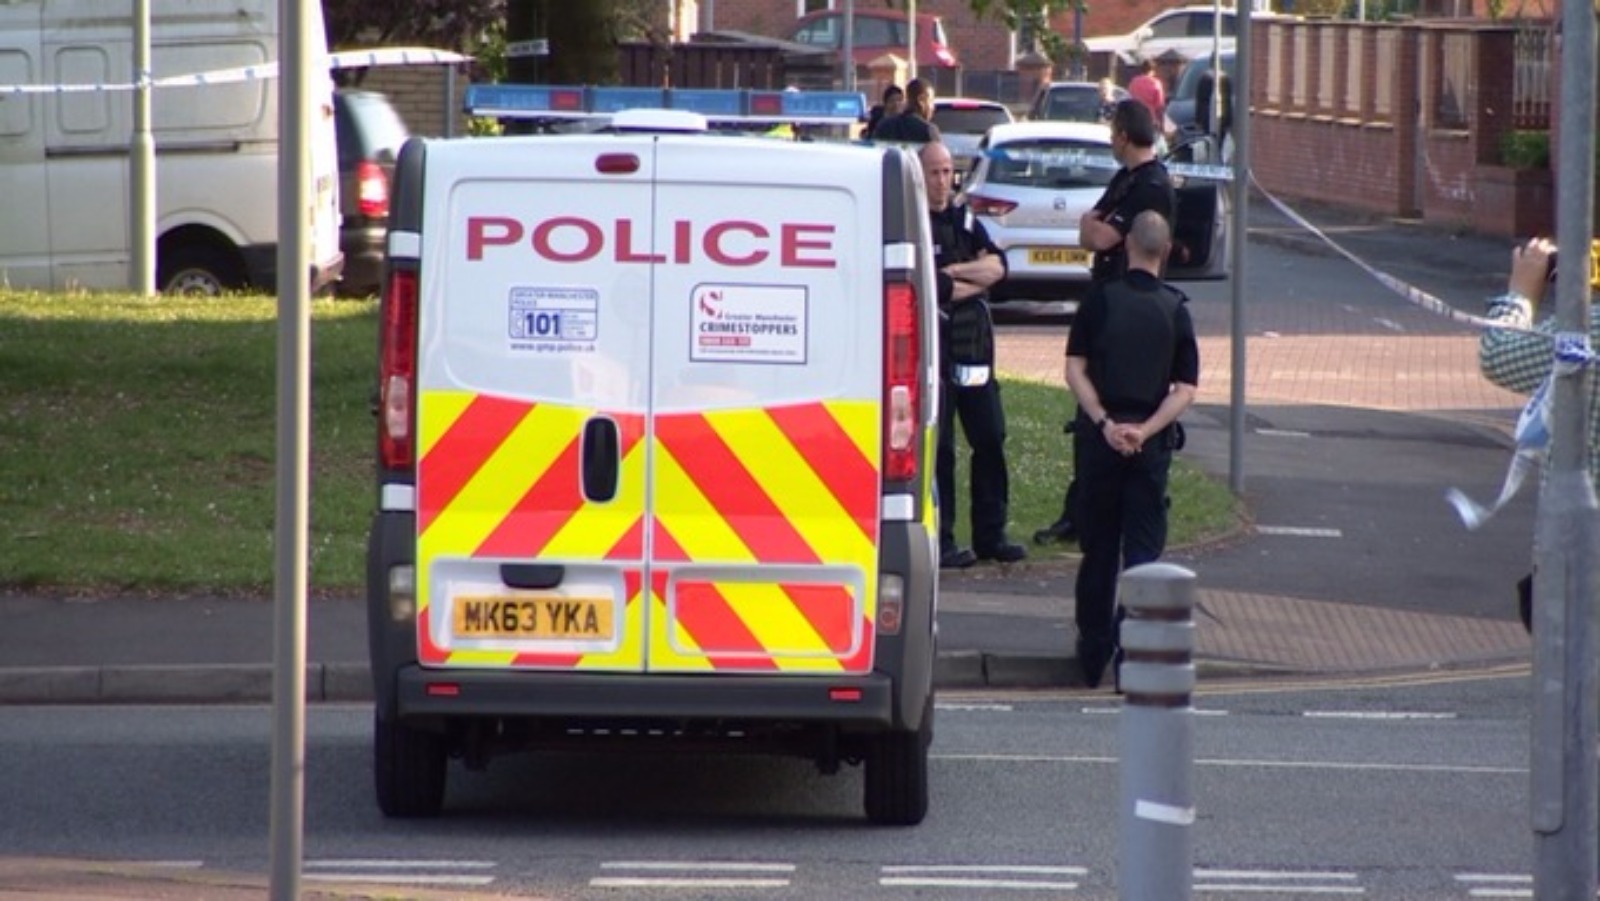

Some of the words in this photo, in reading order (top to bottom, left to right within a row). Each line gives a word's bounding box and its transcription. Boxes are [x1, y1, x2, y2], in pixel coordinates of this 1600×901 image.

[466, 216, 837, 269] POLICE
[526, 312, 560, 335] 101
[699, 321, 798, 335] CRIMESTOPPERS
[510, 342, 596, 353] www.gmp.police.uk
[464, 601, 537, 632] MK63
[546, 602, 599, 633] YKA
